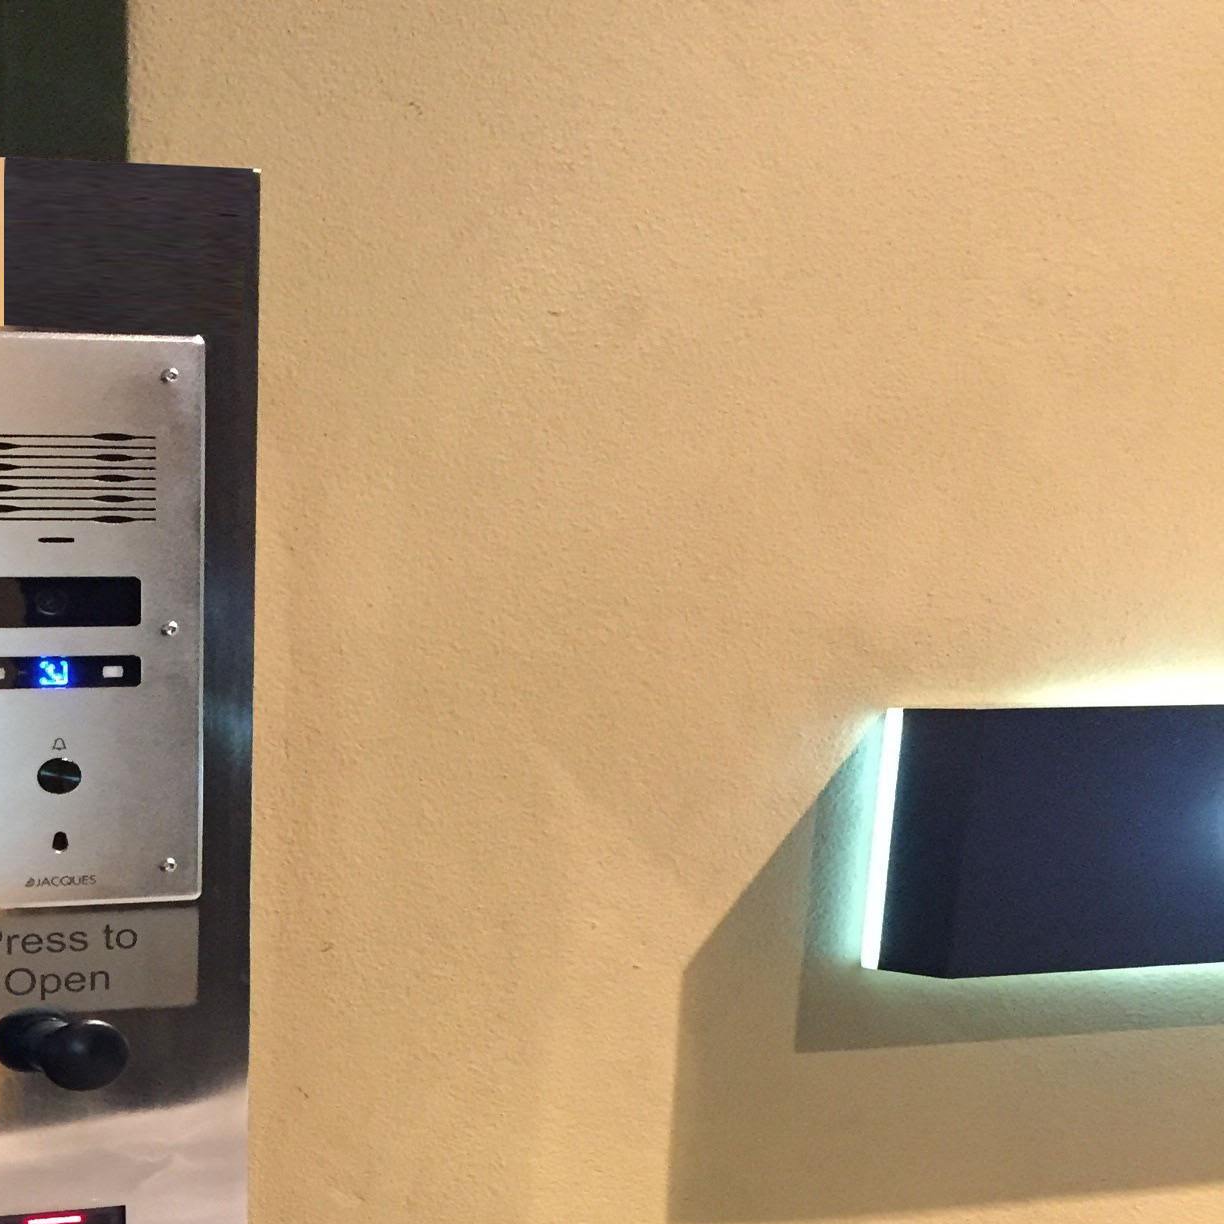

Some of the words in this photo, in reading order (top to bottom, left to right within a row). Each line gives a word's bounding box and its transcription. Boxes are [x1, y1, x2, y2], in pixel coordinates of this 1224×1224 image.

[36, 874, 97, 888] JACQUES
[104, 924, 138, 951] to
[4, 967, 110, 1000] Open
